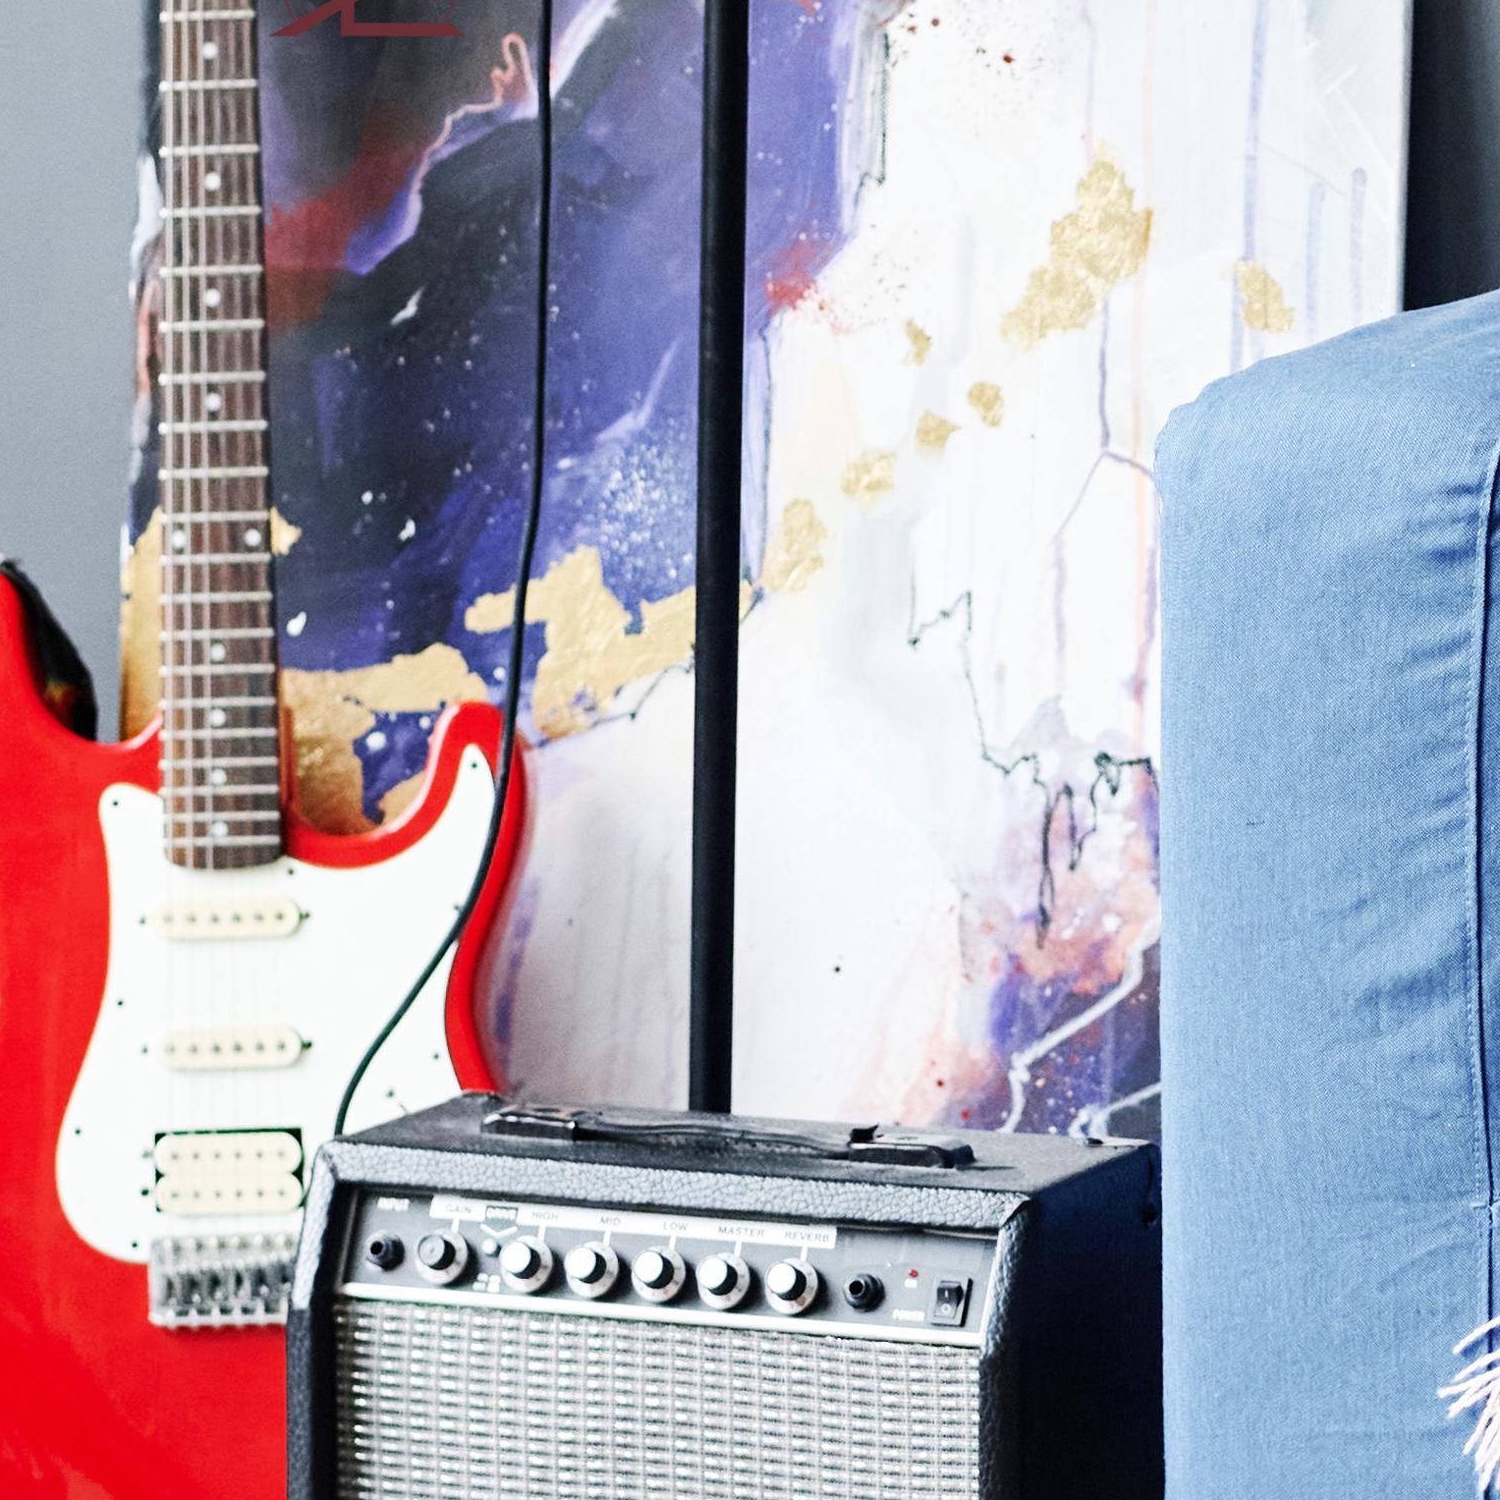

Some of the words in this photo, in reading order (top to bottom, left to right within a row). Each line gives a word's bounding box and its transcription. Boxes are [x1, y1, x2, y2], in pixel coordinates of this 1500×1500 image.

[530, 1210, 560, 1221] HIGH
[598, 1215, 621, 1227] MID
[662, 1220, 689, 1232] LOW
[717, 1225, 765, 1237] MASTER
[784, 1230, 830, 1243] REVERB
